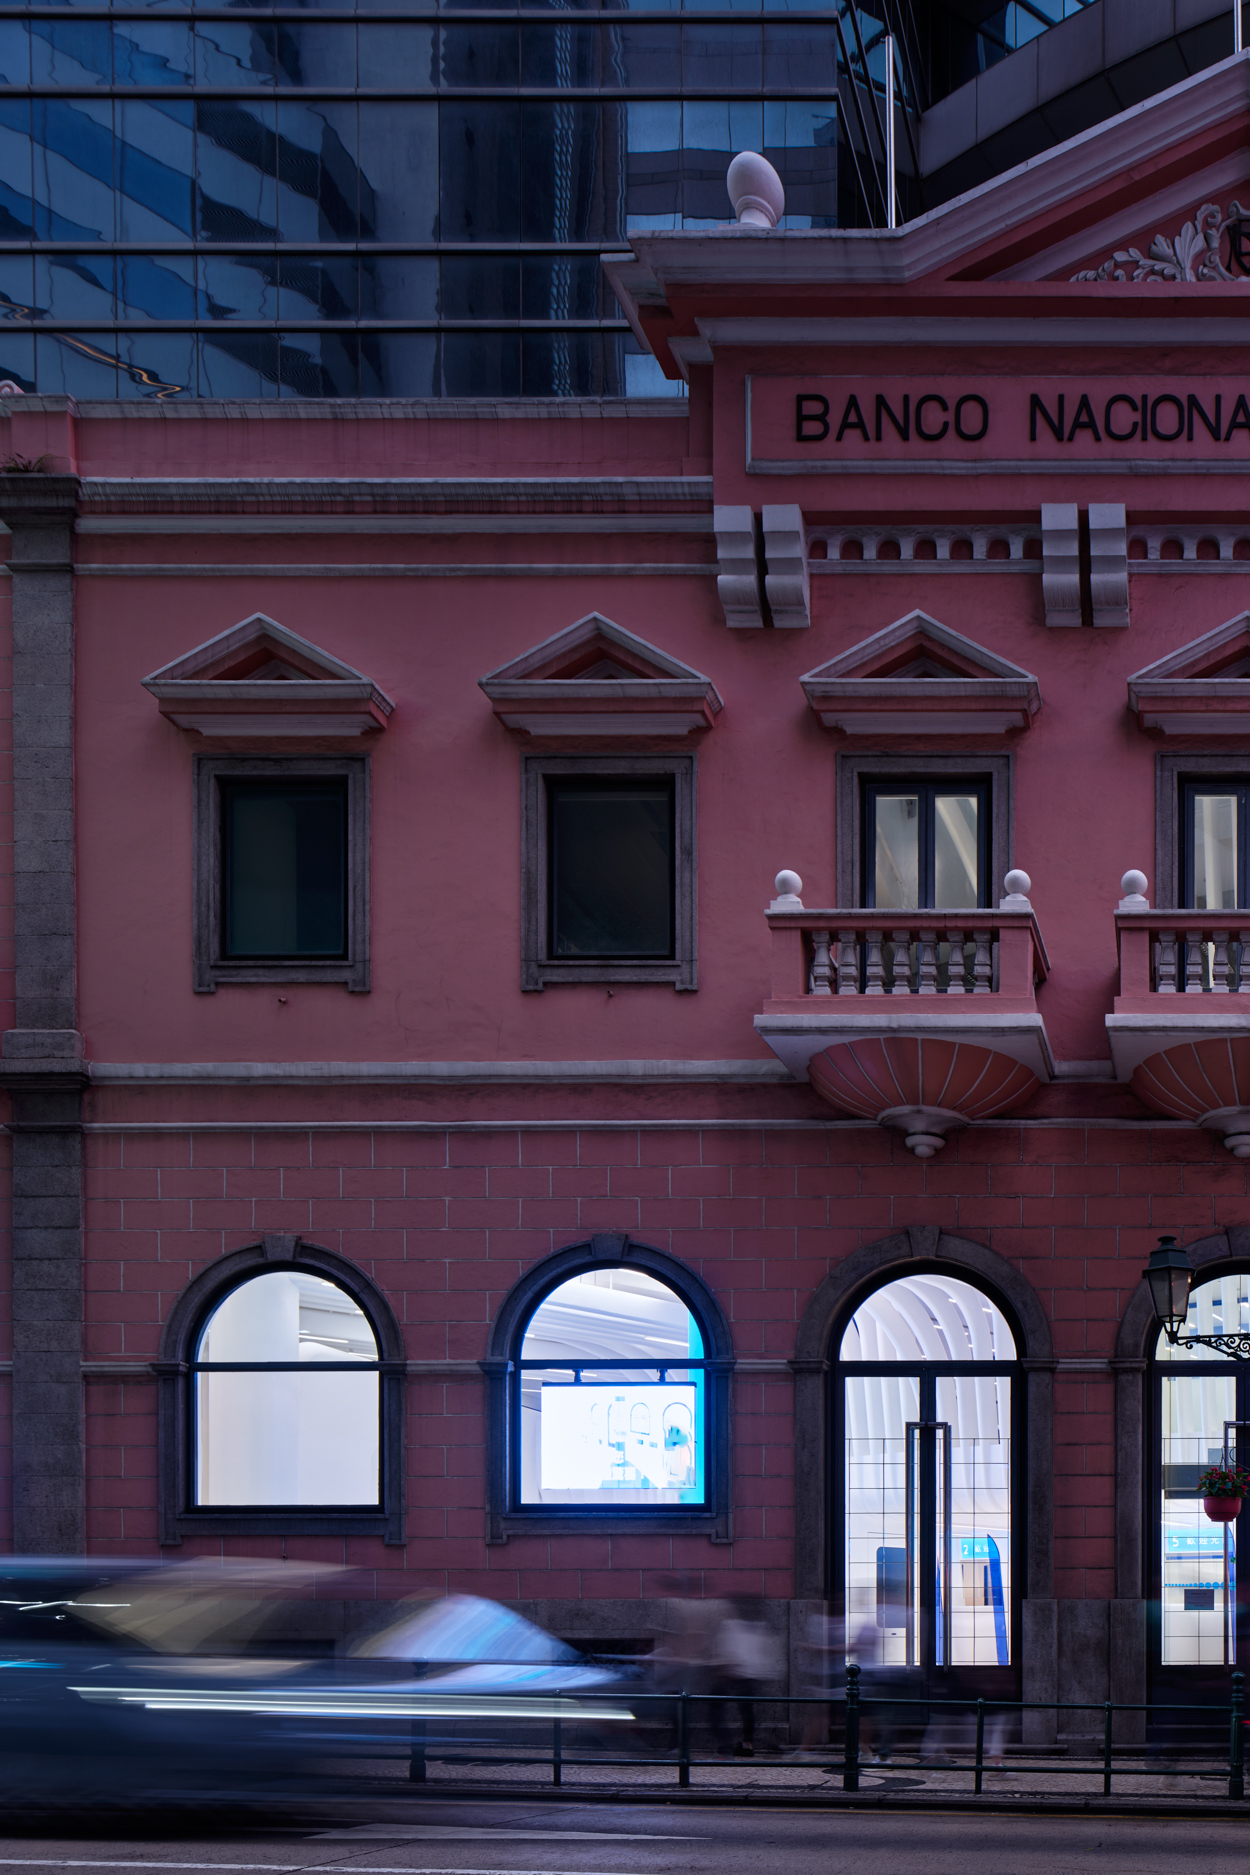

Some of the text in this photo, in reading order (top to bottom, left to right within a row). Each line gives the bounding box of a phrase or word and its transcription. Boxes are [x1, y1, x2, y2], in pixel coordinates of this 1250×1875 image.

[795, 393, 989, 442] BANCO
[1172, 1535, 1179, 1547] 5
[963, 1544, 969, 1555] 2
